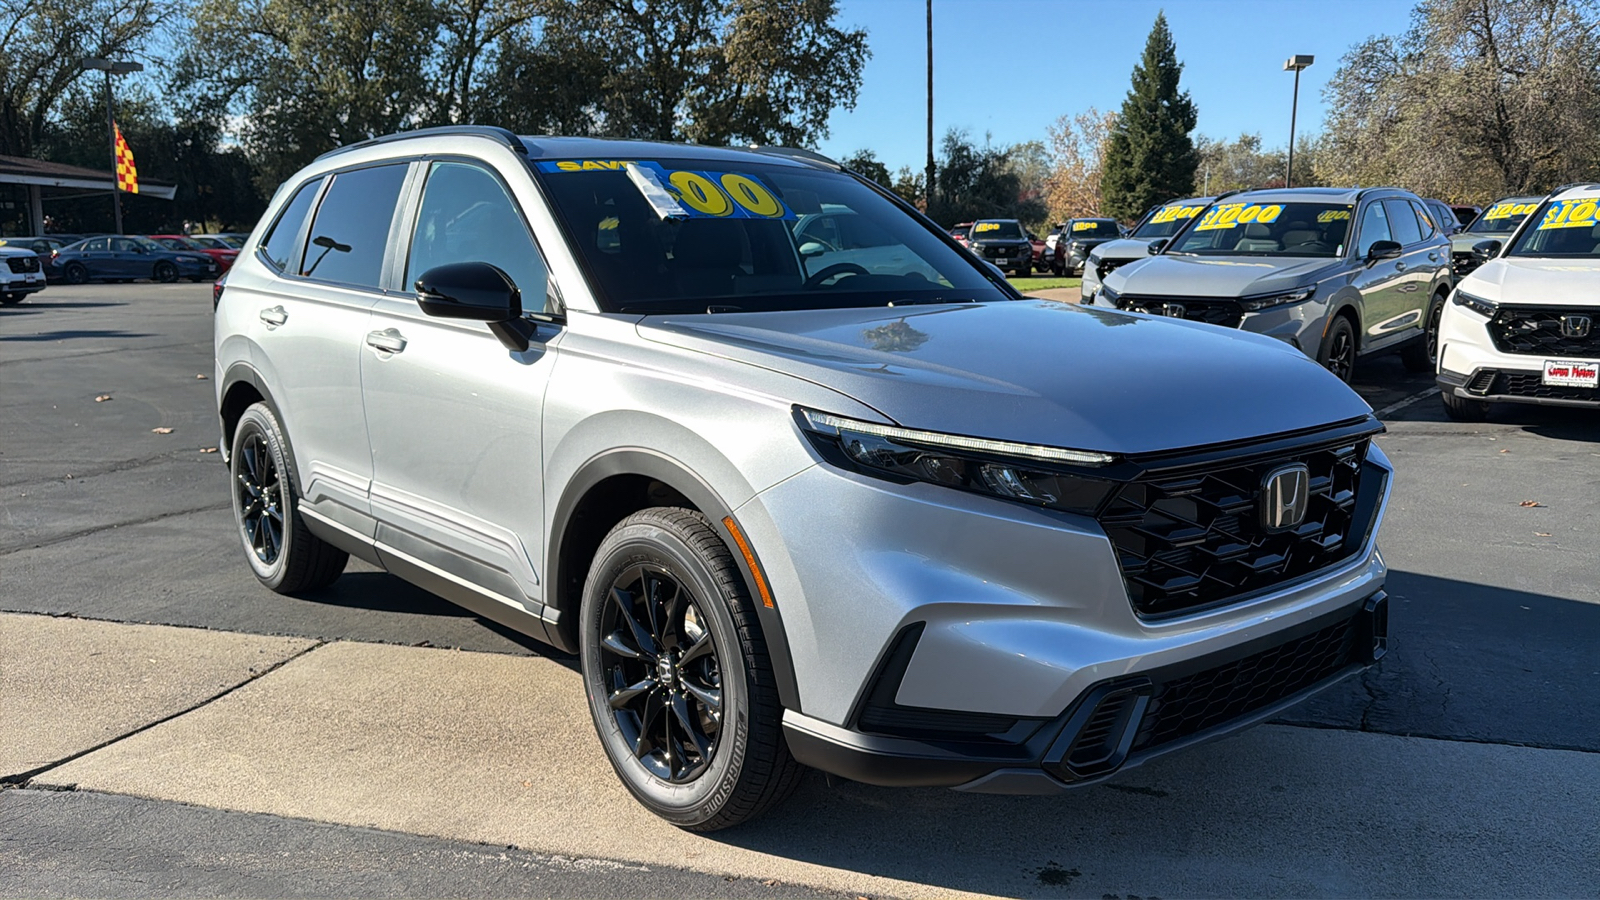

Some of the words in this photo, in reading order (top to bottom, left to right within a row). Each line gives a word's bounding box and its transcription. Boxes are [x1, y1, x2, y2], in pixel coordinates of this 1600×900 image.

[556, 160, 638, 172] SAV
[664, 171, 785, 219] 00
[1201, 204, 1281, 226] $1000
[1543, 202, 1600, 224] $10
[703, 716, 747, 816] BRIDGESTONE
